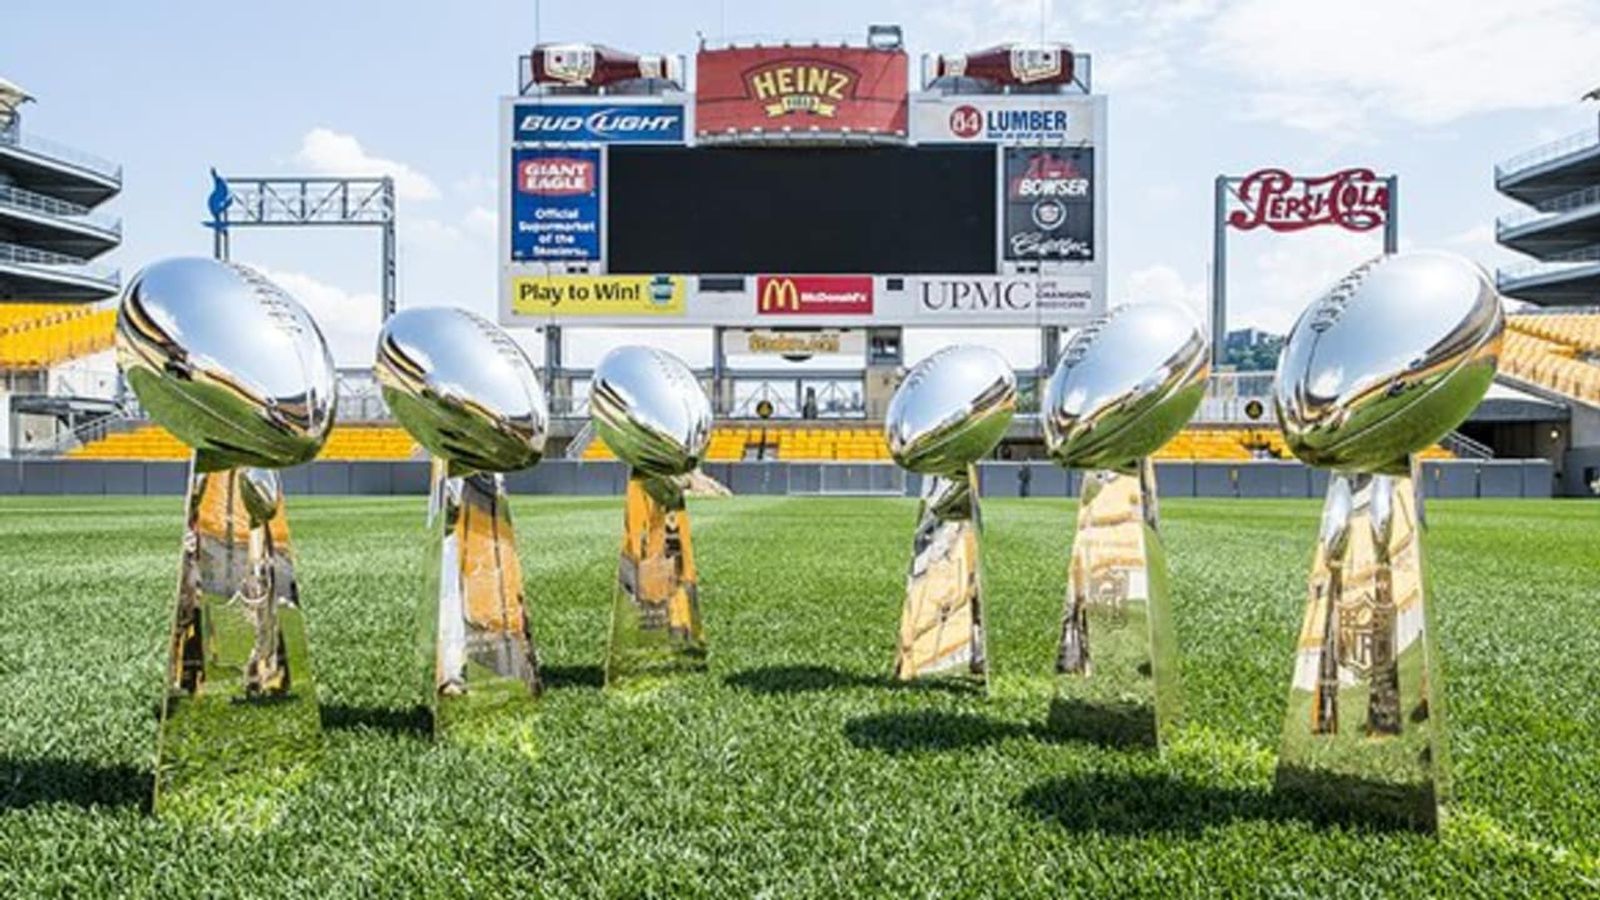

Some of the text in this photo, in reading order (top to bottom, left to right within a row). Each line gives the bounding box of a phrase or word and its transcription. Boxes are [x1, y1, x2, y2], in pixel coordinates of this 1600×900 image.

[753, 67, 849, 100] HEINZ
[519, 115, 679, 131] BUD LIGHT
[952, 110, 1067, 131] 84 LUMBER
[525, 163, 585, 177] GIANT
[527, 176, 585, 190] EAGLE
[1019, 178, 1089, 196] BOWSER
[534, 207, 579, 220] Official
[538, 233, 575, 244] of the
[520, 282, 640, 307] Play to Win!
[921, 281, 1031, 310] UPMC
